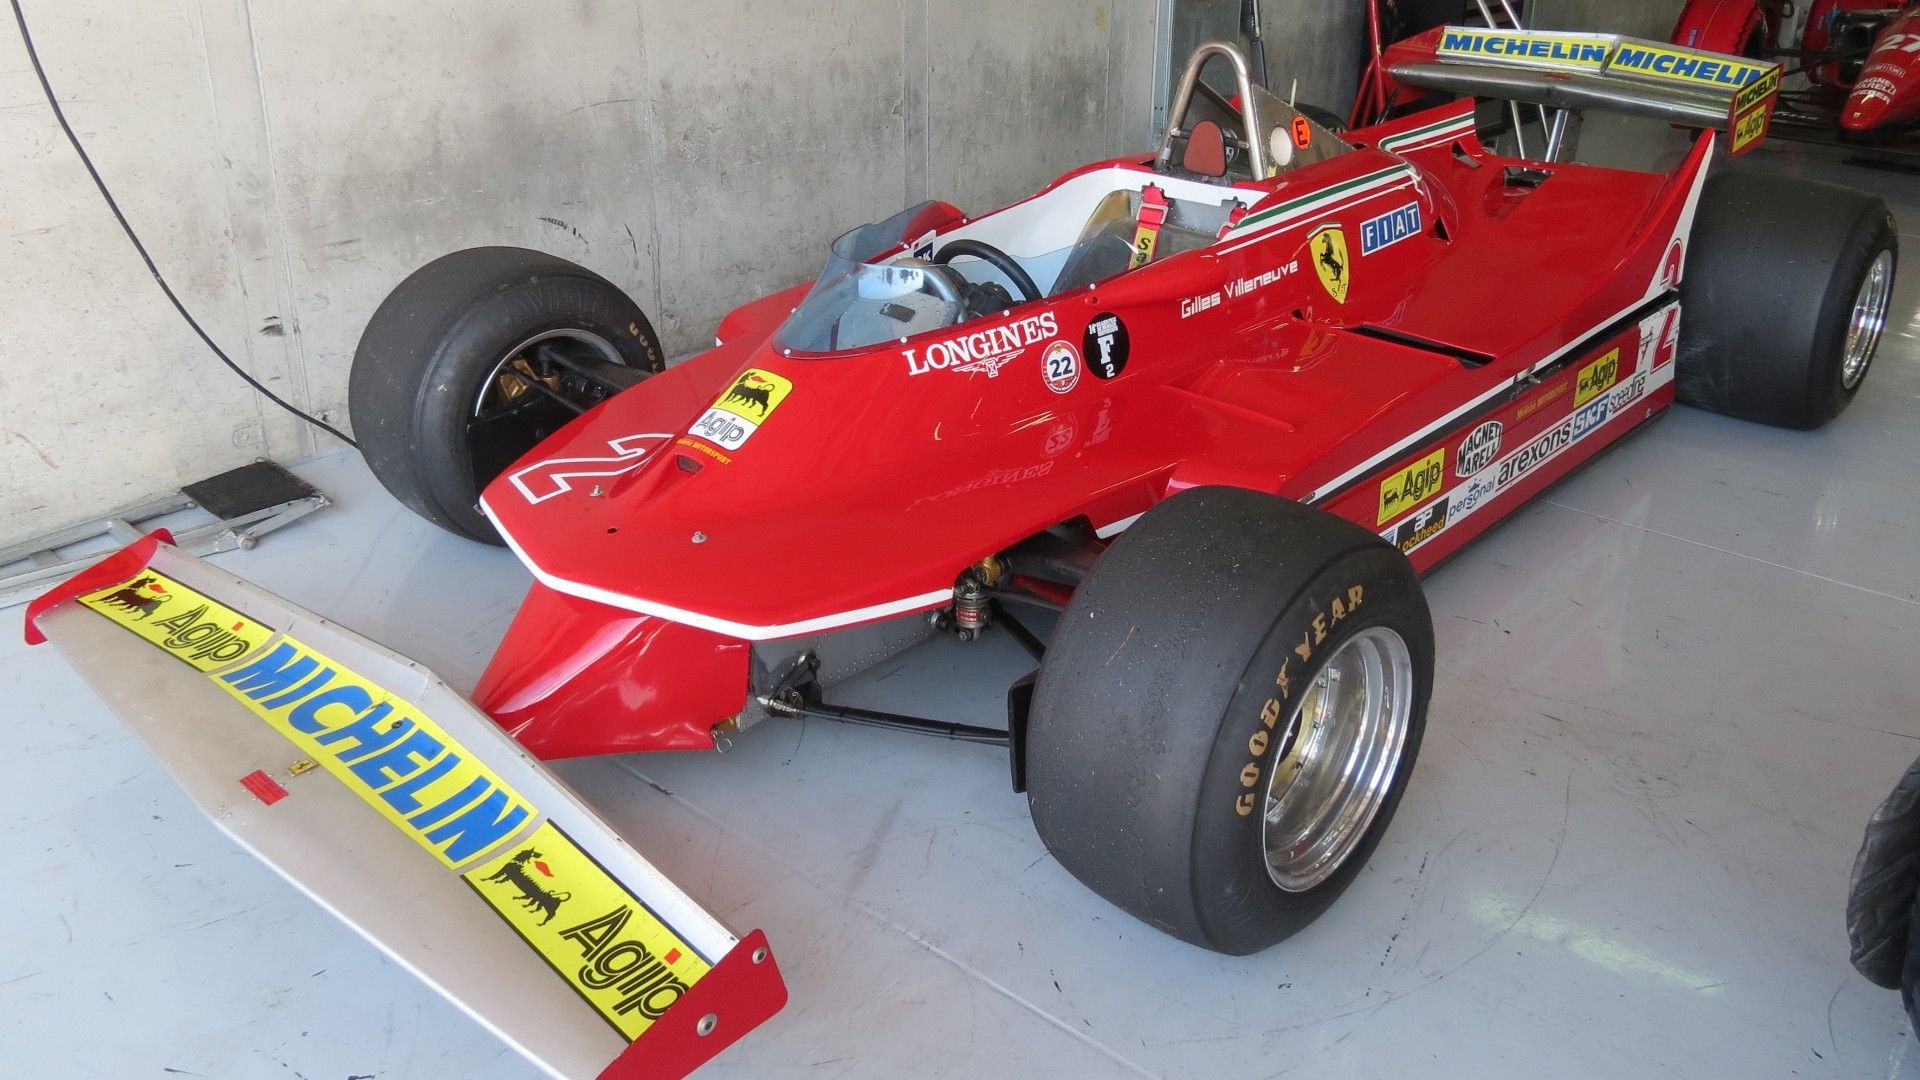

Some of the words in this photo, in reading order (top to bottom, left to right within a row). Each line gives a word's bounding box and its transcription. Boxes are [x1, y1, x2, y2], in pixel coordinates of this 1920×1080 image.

[1443, 34, 1606, 63] MICHELIN
[1295, 119, 1308, 146] E
[1364, 205, 1418, 249] FIAT
[1180, 292, 1221, 319] Gilles
[1224, 260, 1299, 299] Villeneuve
[902, 311, 1058, 376] LONGINES
[1097, 334, 1114, 364] F
[1049, 356, 1073, 379] 22
[1106, 363, 1115, 378] 2
[1589, 356, 1616, 391] Agip
[695, 411, 745, 442] Agip
[1573, 400, 1609, 432] SKF
[1497, 422, 1572, 486] arexons
[1401, 458, 1441, 501] Agip
[1448, 475, 1495, 520] personal
[150, 603, 251, 662] Agip
[218, 641, 531, 863] MICHELIN
[558, 903, 691, 1021] Agip
